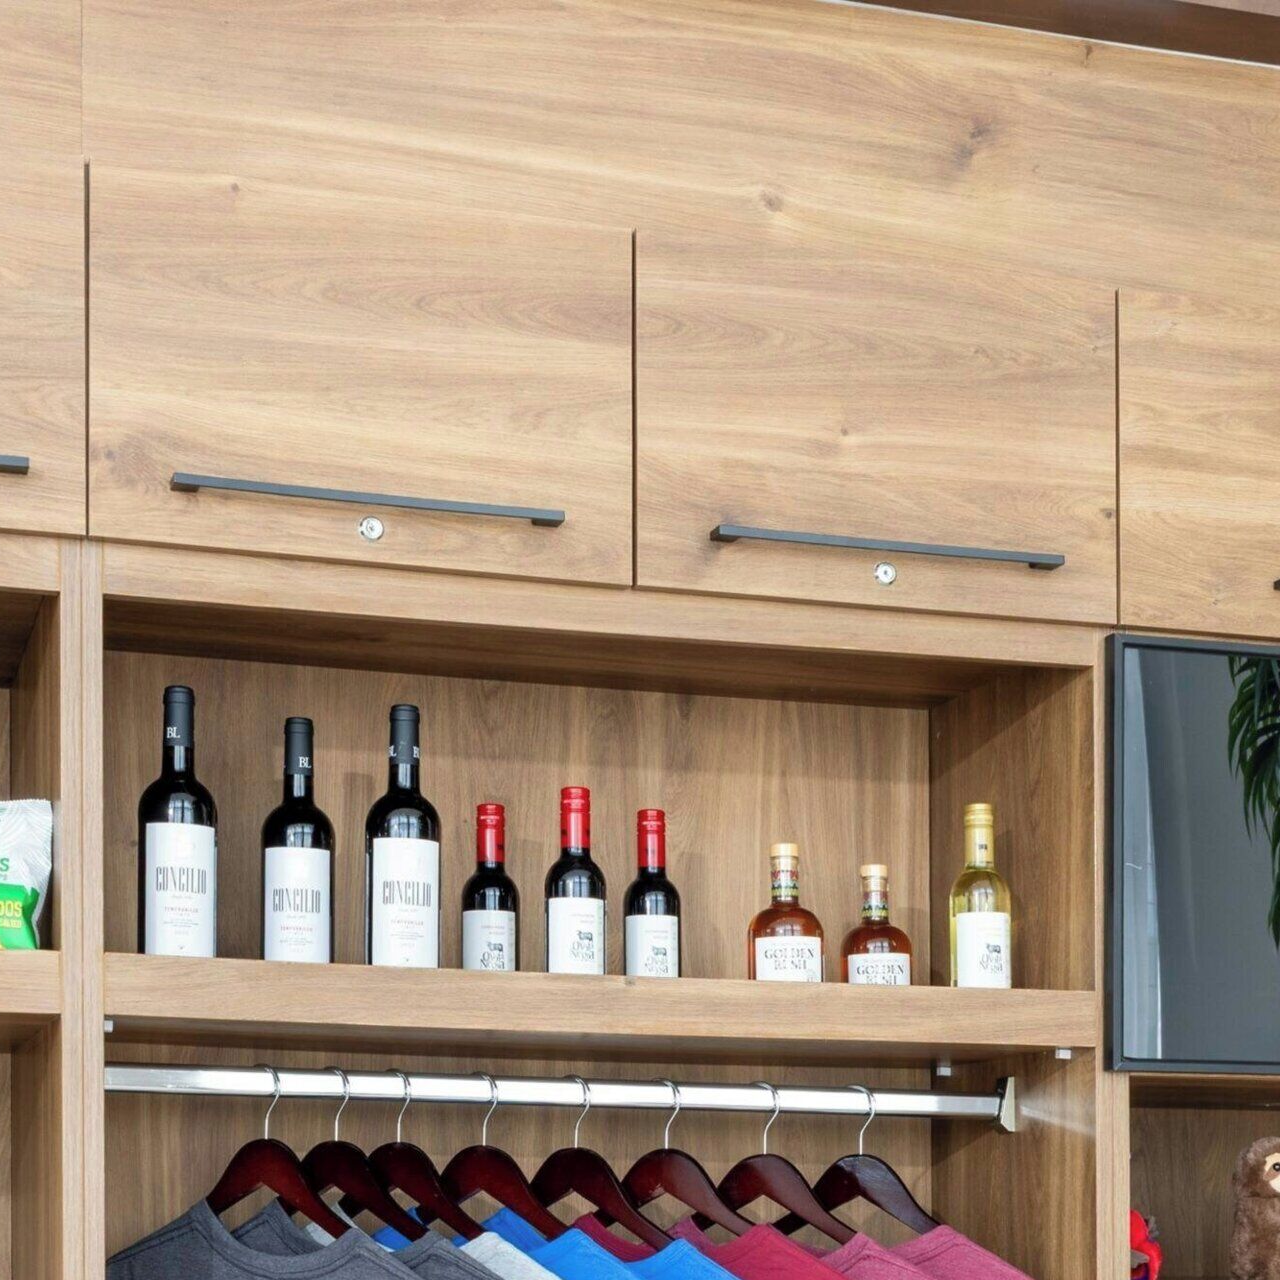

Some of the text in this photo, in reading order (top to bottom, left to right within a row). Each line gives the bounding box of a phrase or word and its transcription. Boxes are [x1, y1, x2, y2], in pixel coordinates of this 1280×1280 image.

[167, 727, 180, 738] BL
[299, 756, 311, 768] BL
[156, 866, 207, 895] CONCILIO
[383, 881, 431, 907] CONCILIO
[273, 888, 320, 914] CONCILIO
[765, 948, 814, 961] GOLDEN
[857, 964, 904, 976] GOLDEN
